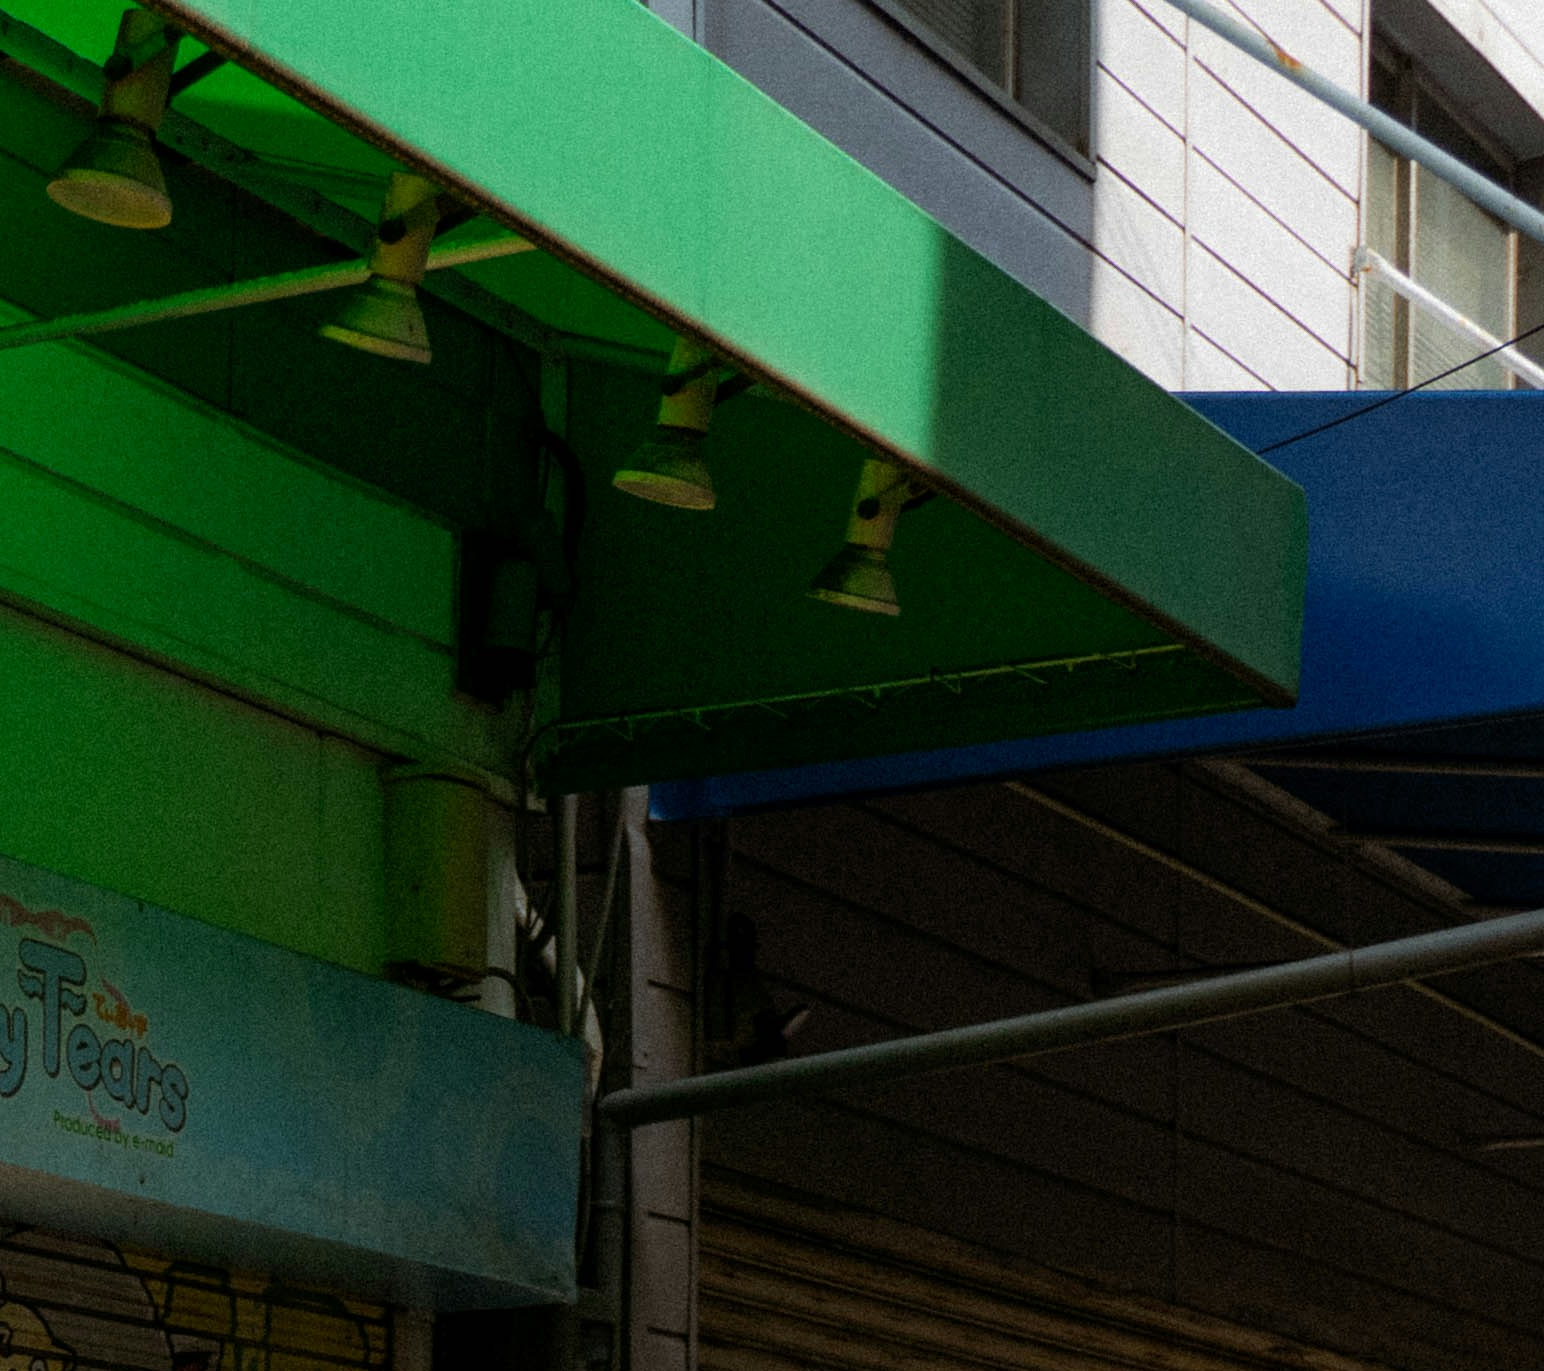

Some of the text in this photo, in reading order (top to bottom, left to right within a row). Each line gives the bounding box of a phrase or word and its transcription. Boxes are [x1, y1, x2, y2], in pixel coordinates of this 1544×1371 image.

[19, 938, 189, 1132] Tears
[53, 1110, 174, 1160] Produced by e-maid
